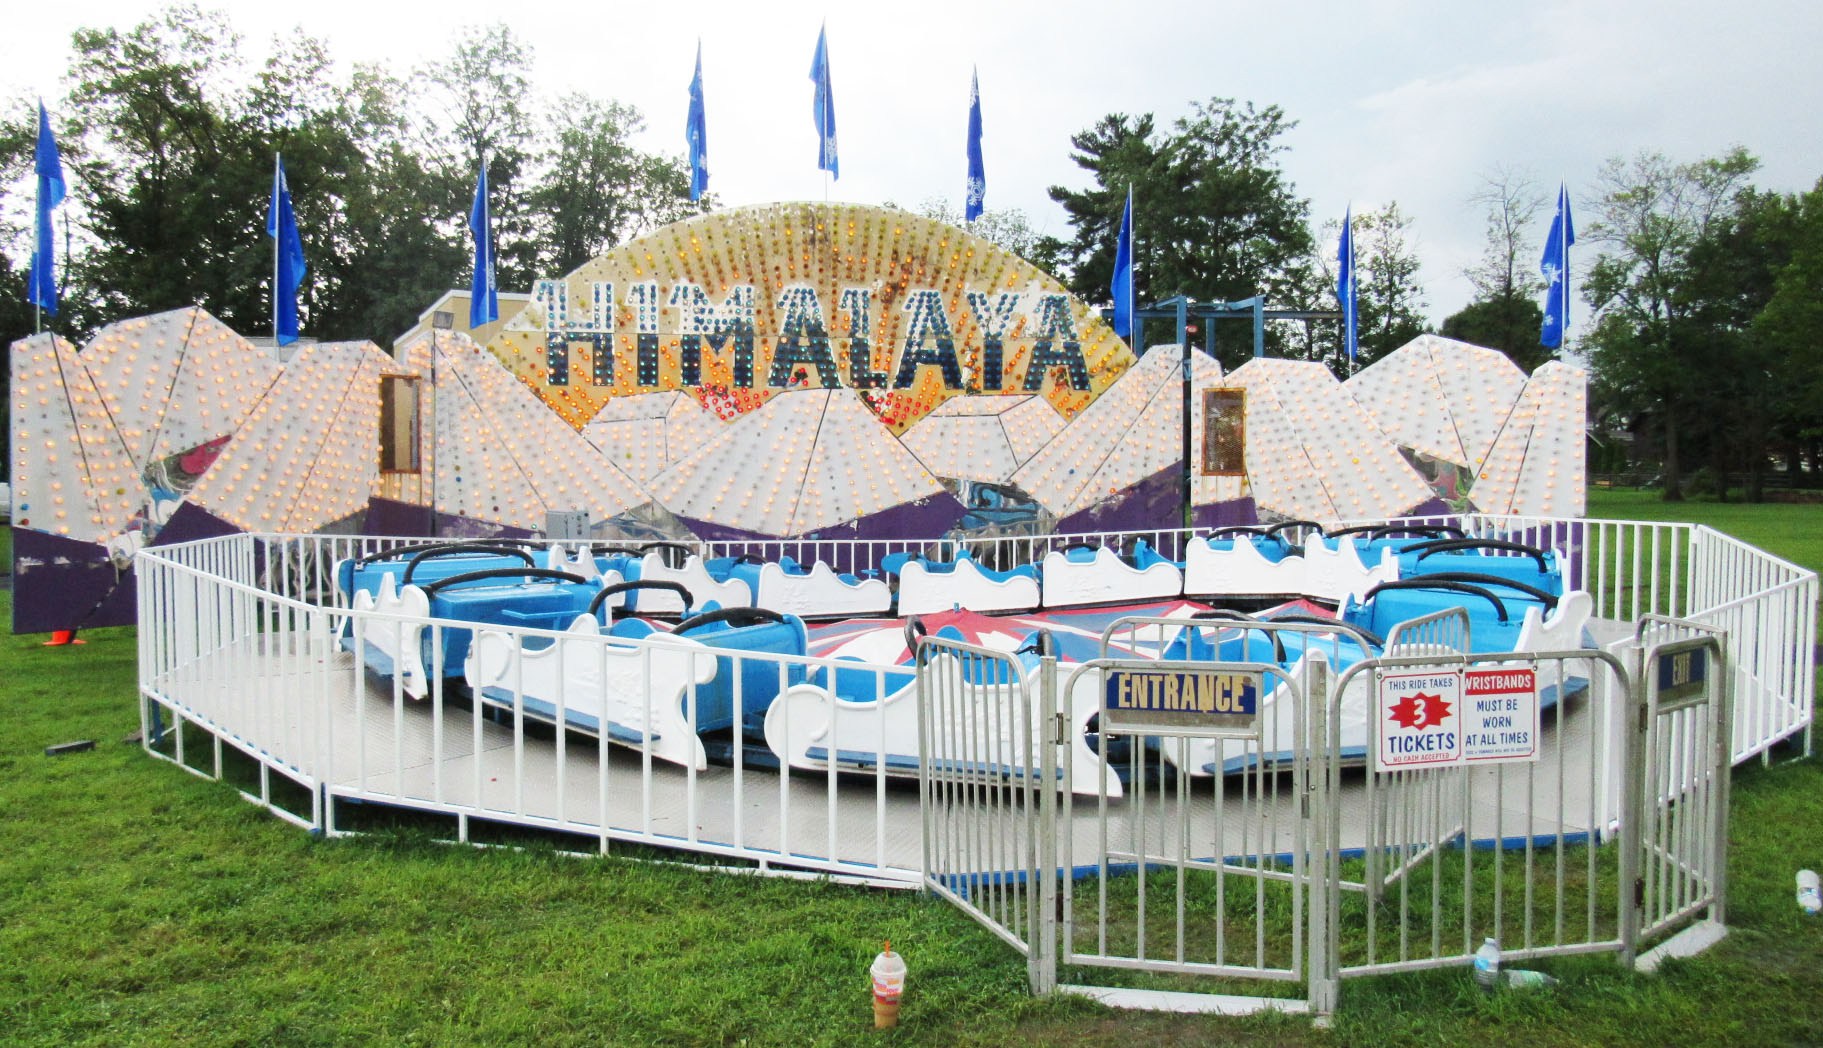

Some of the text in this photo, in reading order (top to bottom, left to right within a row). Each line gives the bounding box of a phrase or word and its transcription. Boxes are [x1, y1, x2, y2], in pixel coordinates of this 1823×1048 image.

[536, 281, 1091, 391] HIMALAYA
[1389, 678, 1453, 690] THIS RIDE TAKES
[1118, 672, 1244, 713] ENTRANCE
[1413, 698, 1426, 725] 3
[1476, 698, 1518, 712] MUST BE
[1482, 716, 1512, 728] WORN
[1388, 732, 1455, 753] TICKETS
[1465, 731, 1528, 747] AT ALL TIMES
[1393, 752, 1450, 763] NO CASH ACCEPTED
